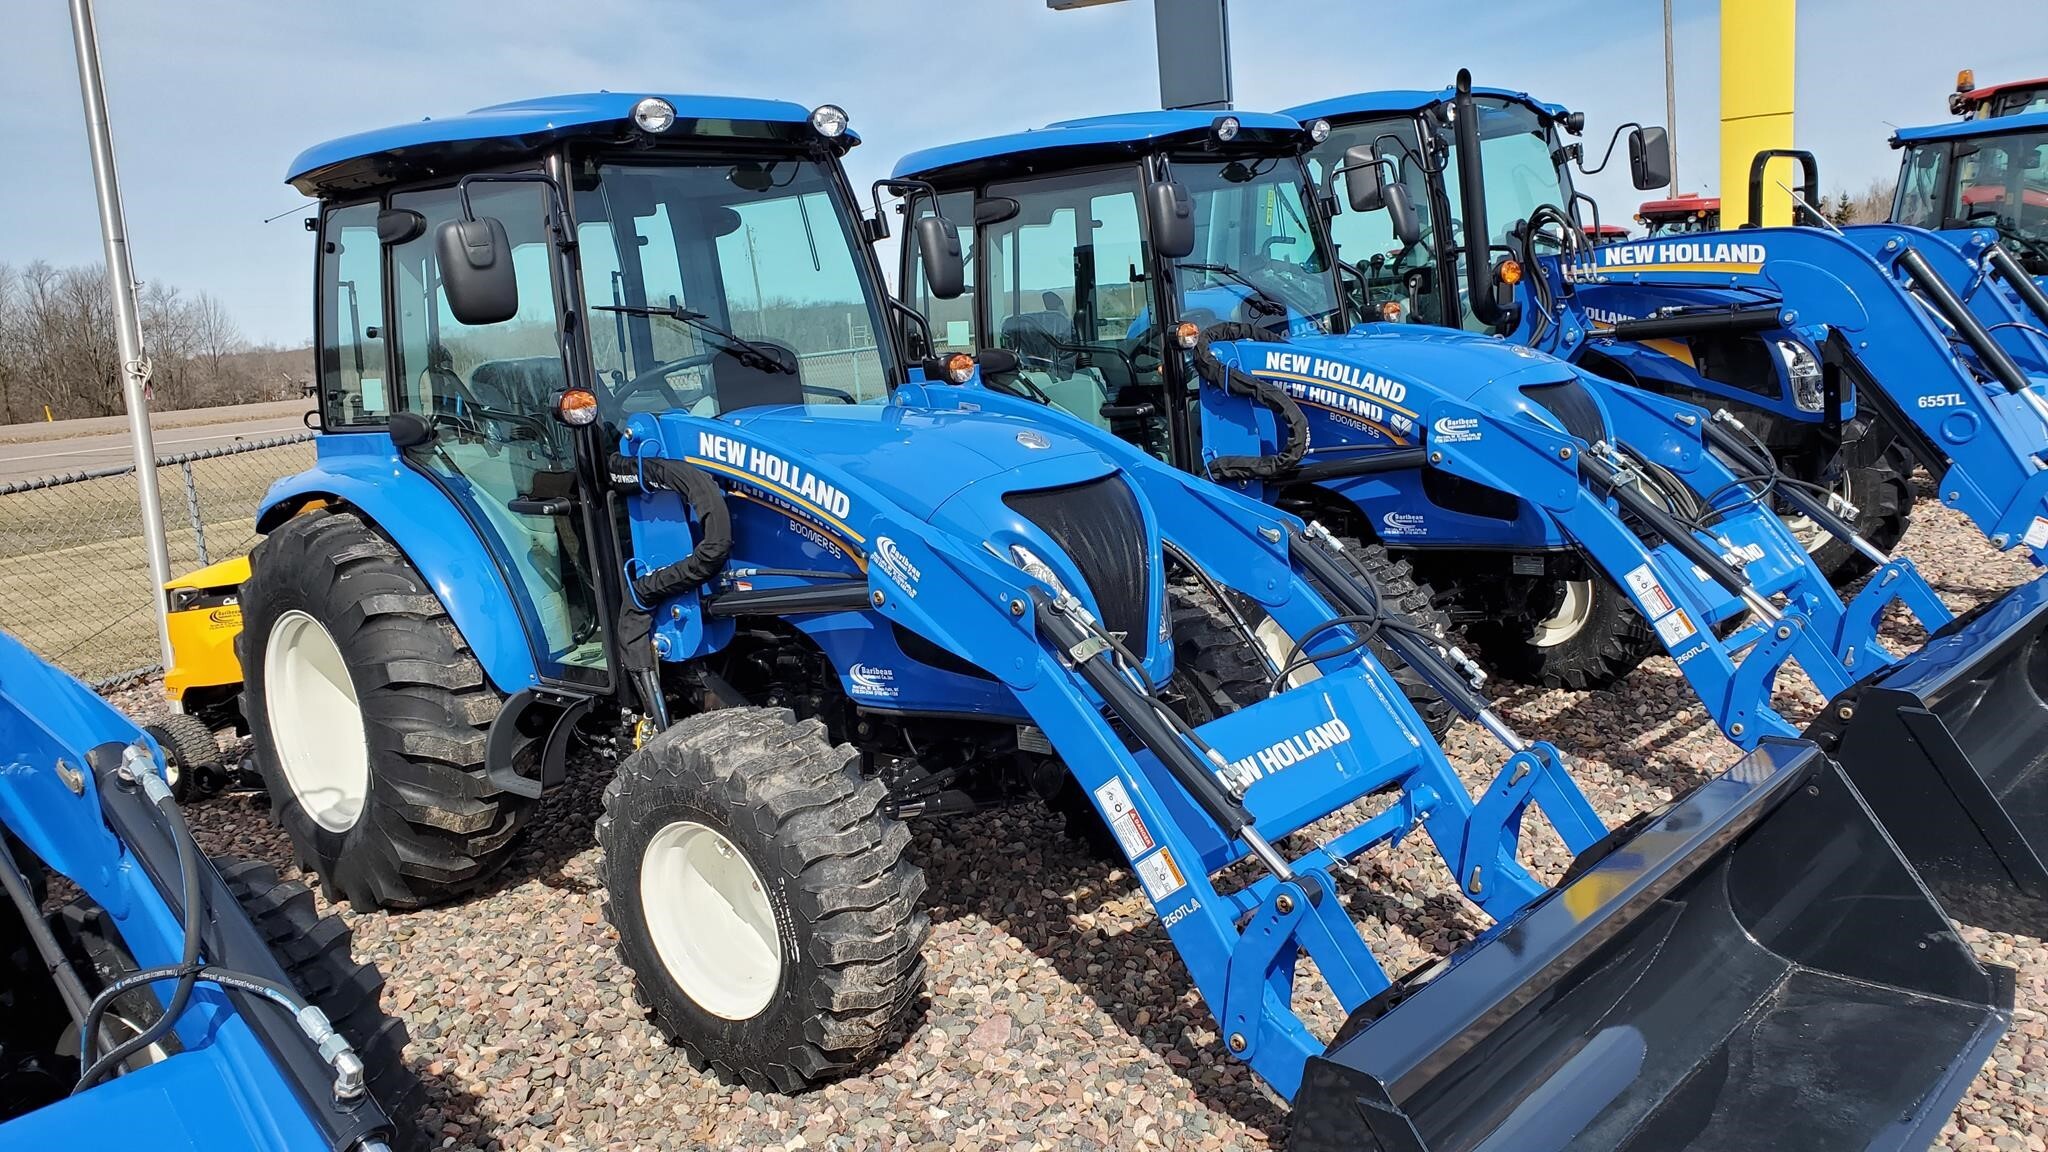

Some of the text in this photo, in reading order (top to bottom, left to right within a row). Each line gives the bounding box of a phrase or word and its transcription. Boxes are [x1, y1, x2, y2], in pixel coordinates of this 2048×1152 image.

[1605, 243, 1766, 265] NEW HOLLAND
[1266, 351, 1406, 403] NEW HOLLAND
[1309, 386, 1383, 423] HOLLAND
[1918, 394, 1966, 408] 655TL
[699, 431, 747, 468] NEW
[750, 447, 850, 520] HOLLAND
[1676, 641, 1710, 665] 260TLA
[1256, 718, 1351, 775] HOLLAND
[1162, 898, 1202, 929] 260TLA
